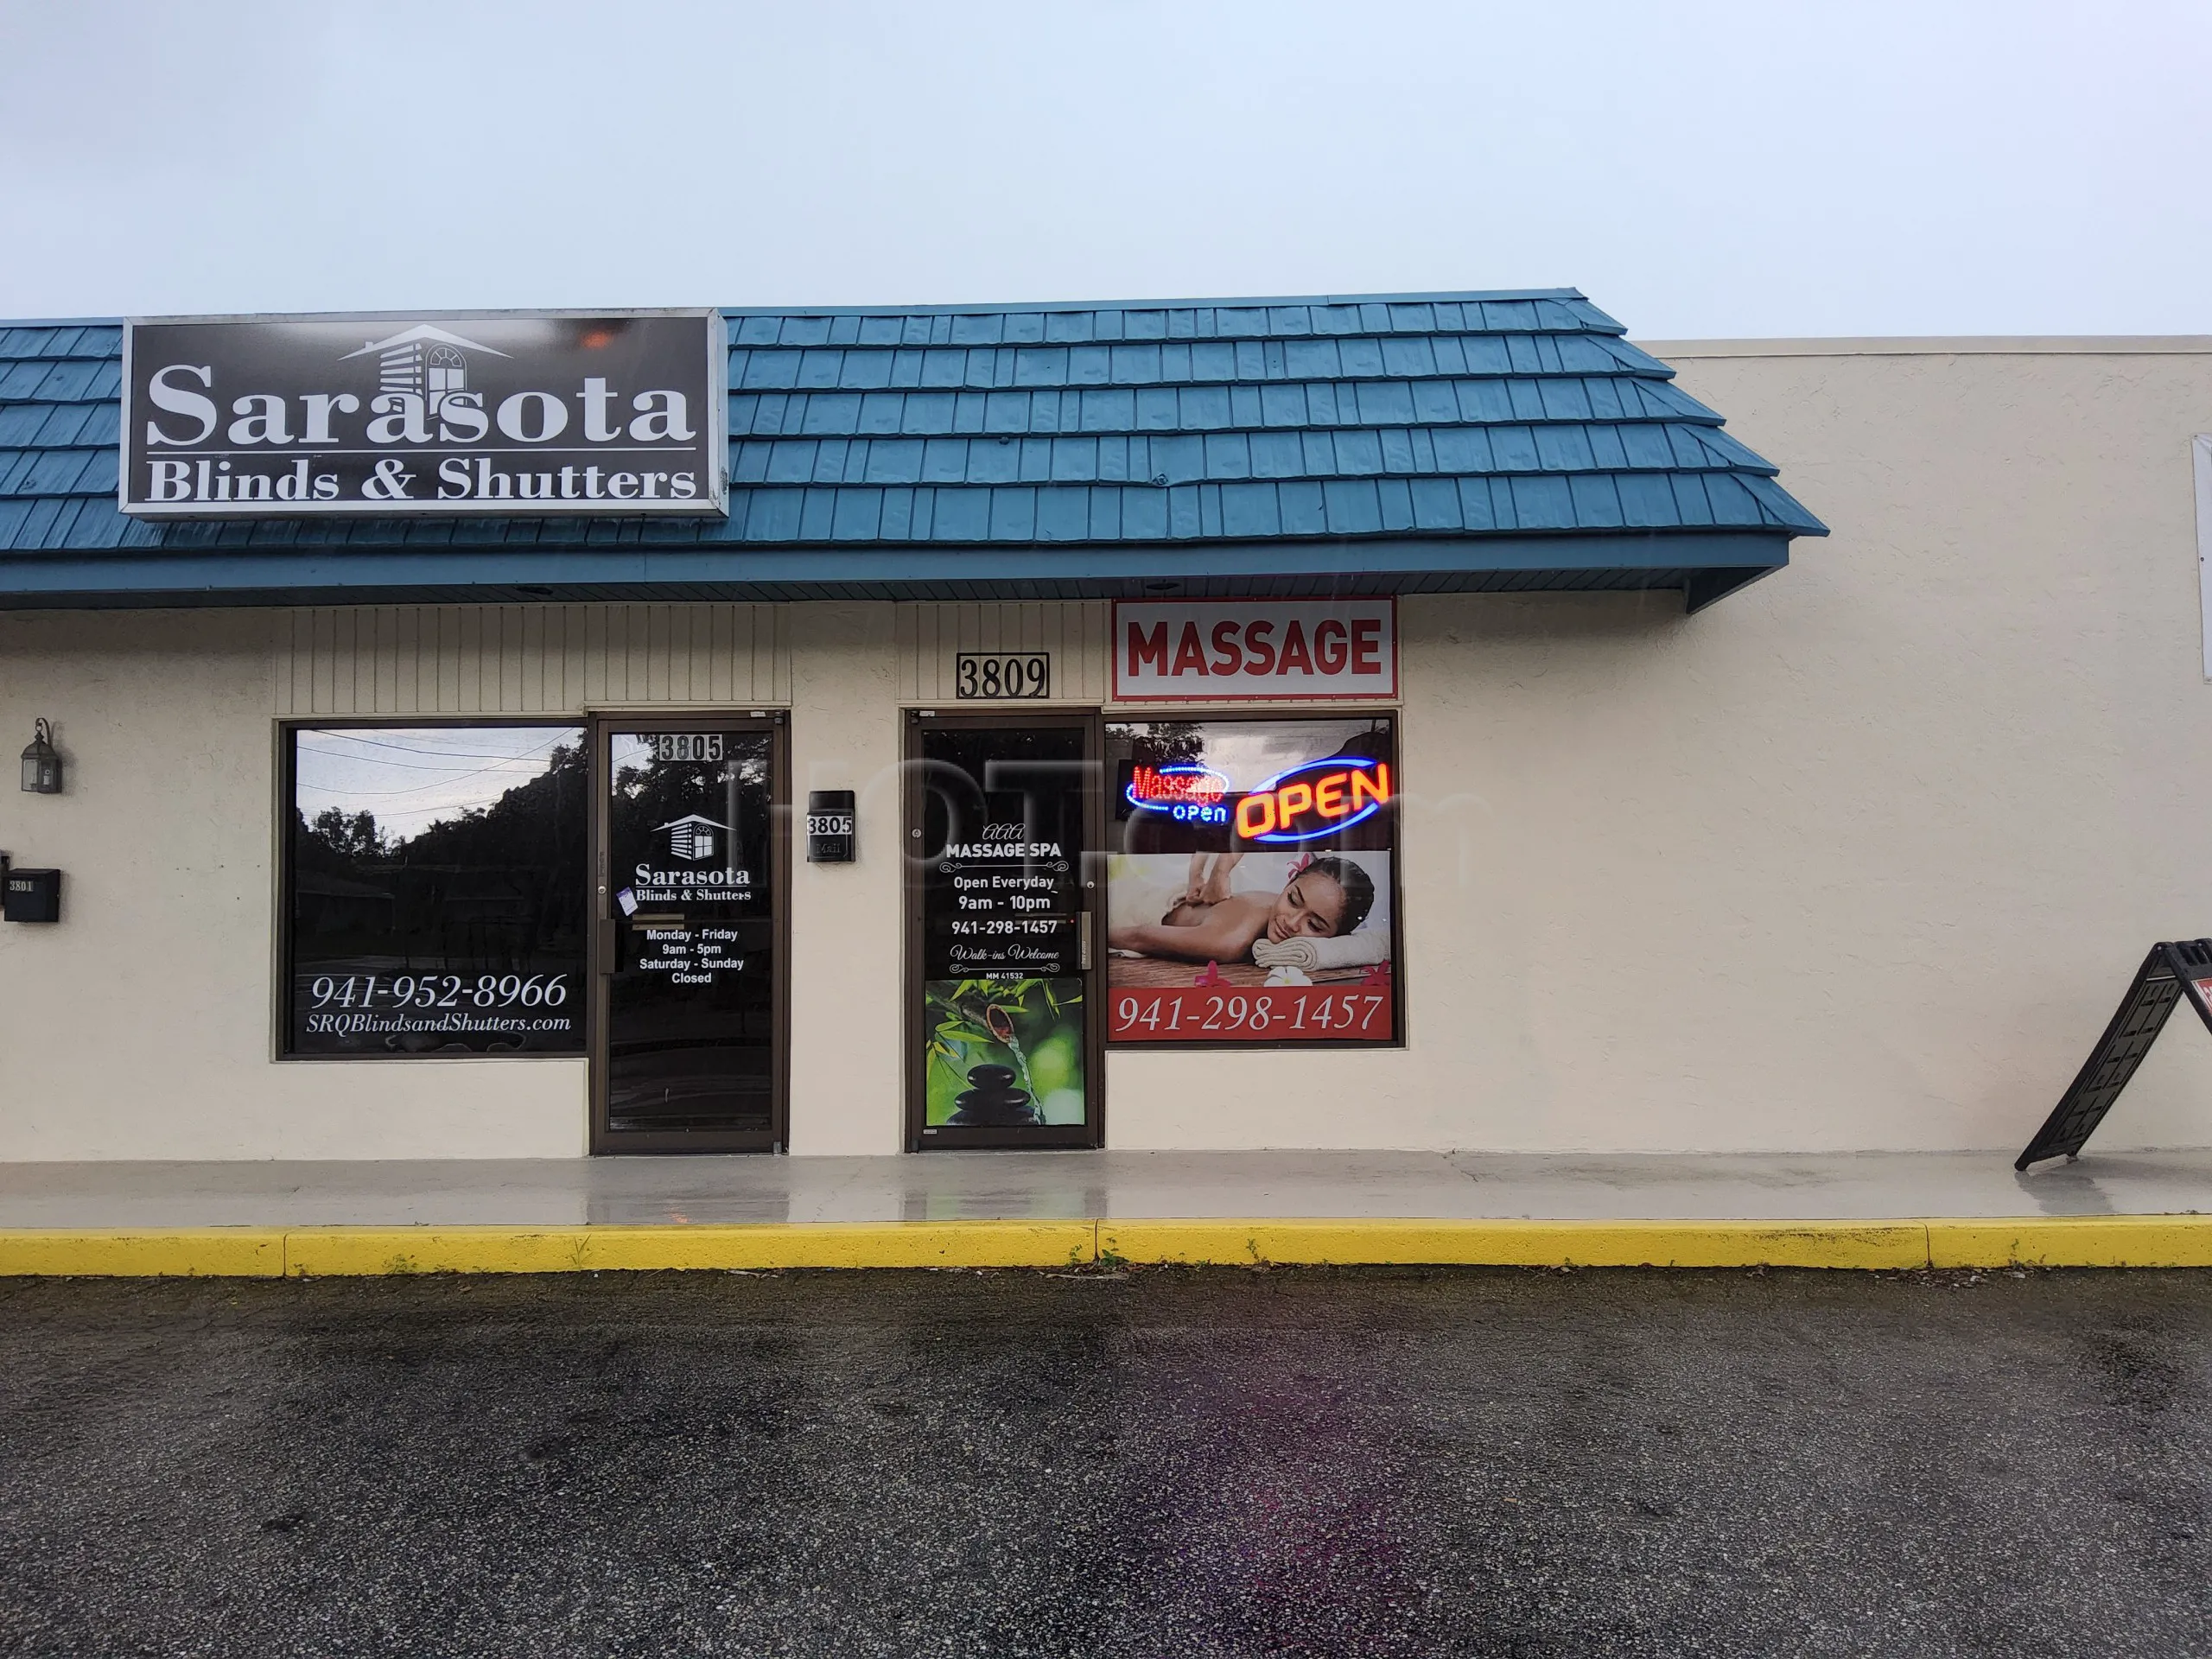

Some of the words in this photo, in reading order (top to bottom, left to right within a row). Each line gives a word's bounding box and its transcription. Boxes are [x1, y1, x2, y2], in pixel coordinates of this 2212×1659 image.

[147, 364, 697, 446] Sarasota
[144, 459, 340, 502] Blinds
[360, 458, 416, 500] &
[436, 457, 697, 500] Shutters
[1127, 619, 1382, 677] MASSAGE
[960, 658, 1046, 698] 3809
[660, 734, 721, 760] 3805
[1132, 766, 1224, 807] Massage
[1236, 762, 1393, 839] OPEN
[807, 817, 853, 834] 3805
[816, 842, 842, 854] Mail
[946, 843, 1026, 858] MASSAGE
[1029, 842, 1062, 857] SPA
[635, 863, 751, 886] Sarasota
[953, 877, 988, 891] Open
[992, 875, 1055, 890] Everyday
[10, 880, 33, 892] 3801
[635, 889, 677, 901] Blinds
[680, 889, 693, 900] &
[696, 889, 752, 901] Shutters
[958, 895, 993, 910] 9am
[1009, 895, 1051, 912] 10pm
[646, 929, 691, 943] Monday
[702, 928, 738, 942] Friday
[951, 919, 1058, 935] 941-298-1457
[662, 944, 686, 955] 9am
[696, 944, 721, 957] 5pm
[950, 944, 1006, 961] Walk-ins
[1007, 944, 1060, 960] Welcome
[639, 957, 690, 971] Saturday
[701, 957, 744, 971] Sunday
[671, 972, 712, 984] Closed
[311, 973, 569, 1009] 941-952-8966
[1114, 994, 1383, 1032] 941-298-1457
[306, 1013, 571, 1037] SRQBlindsandShutters.com
